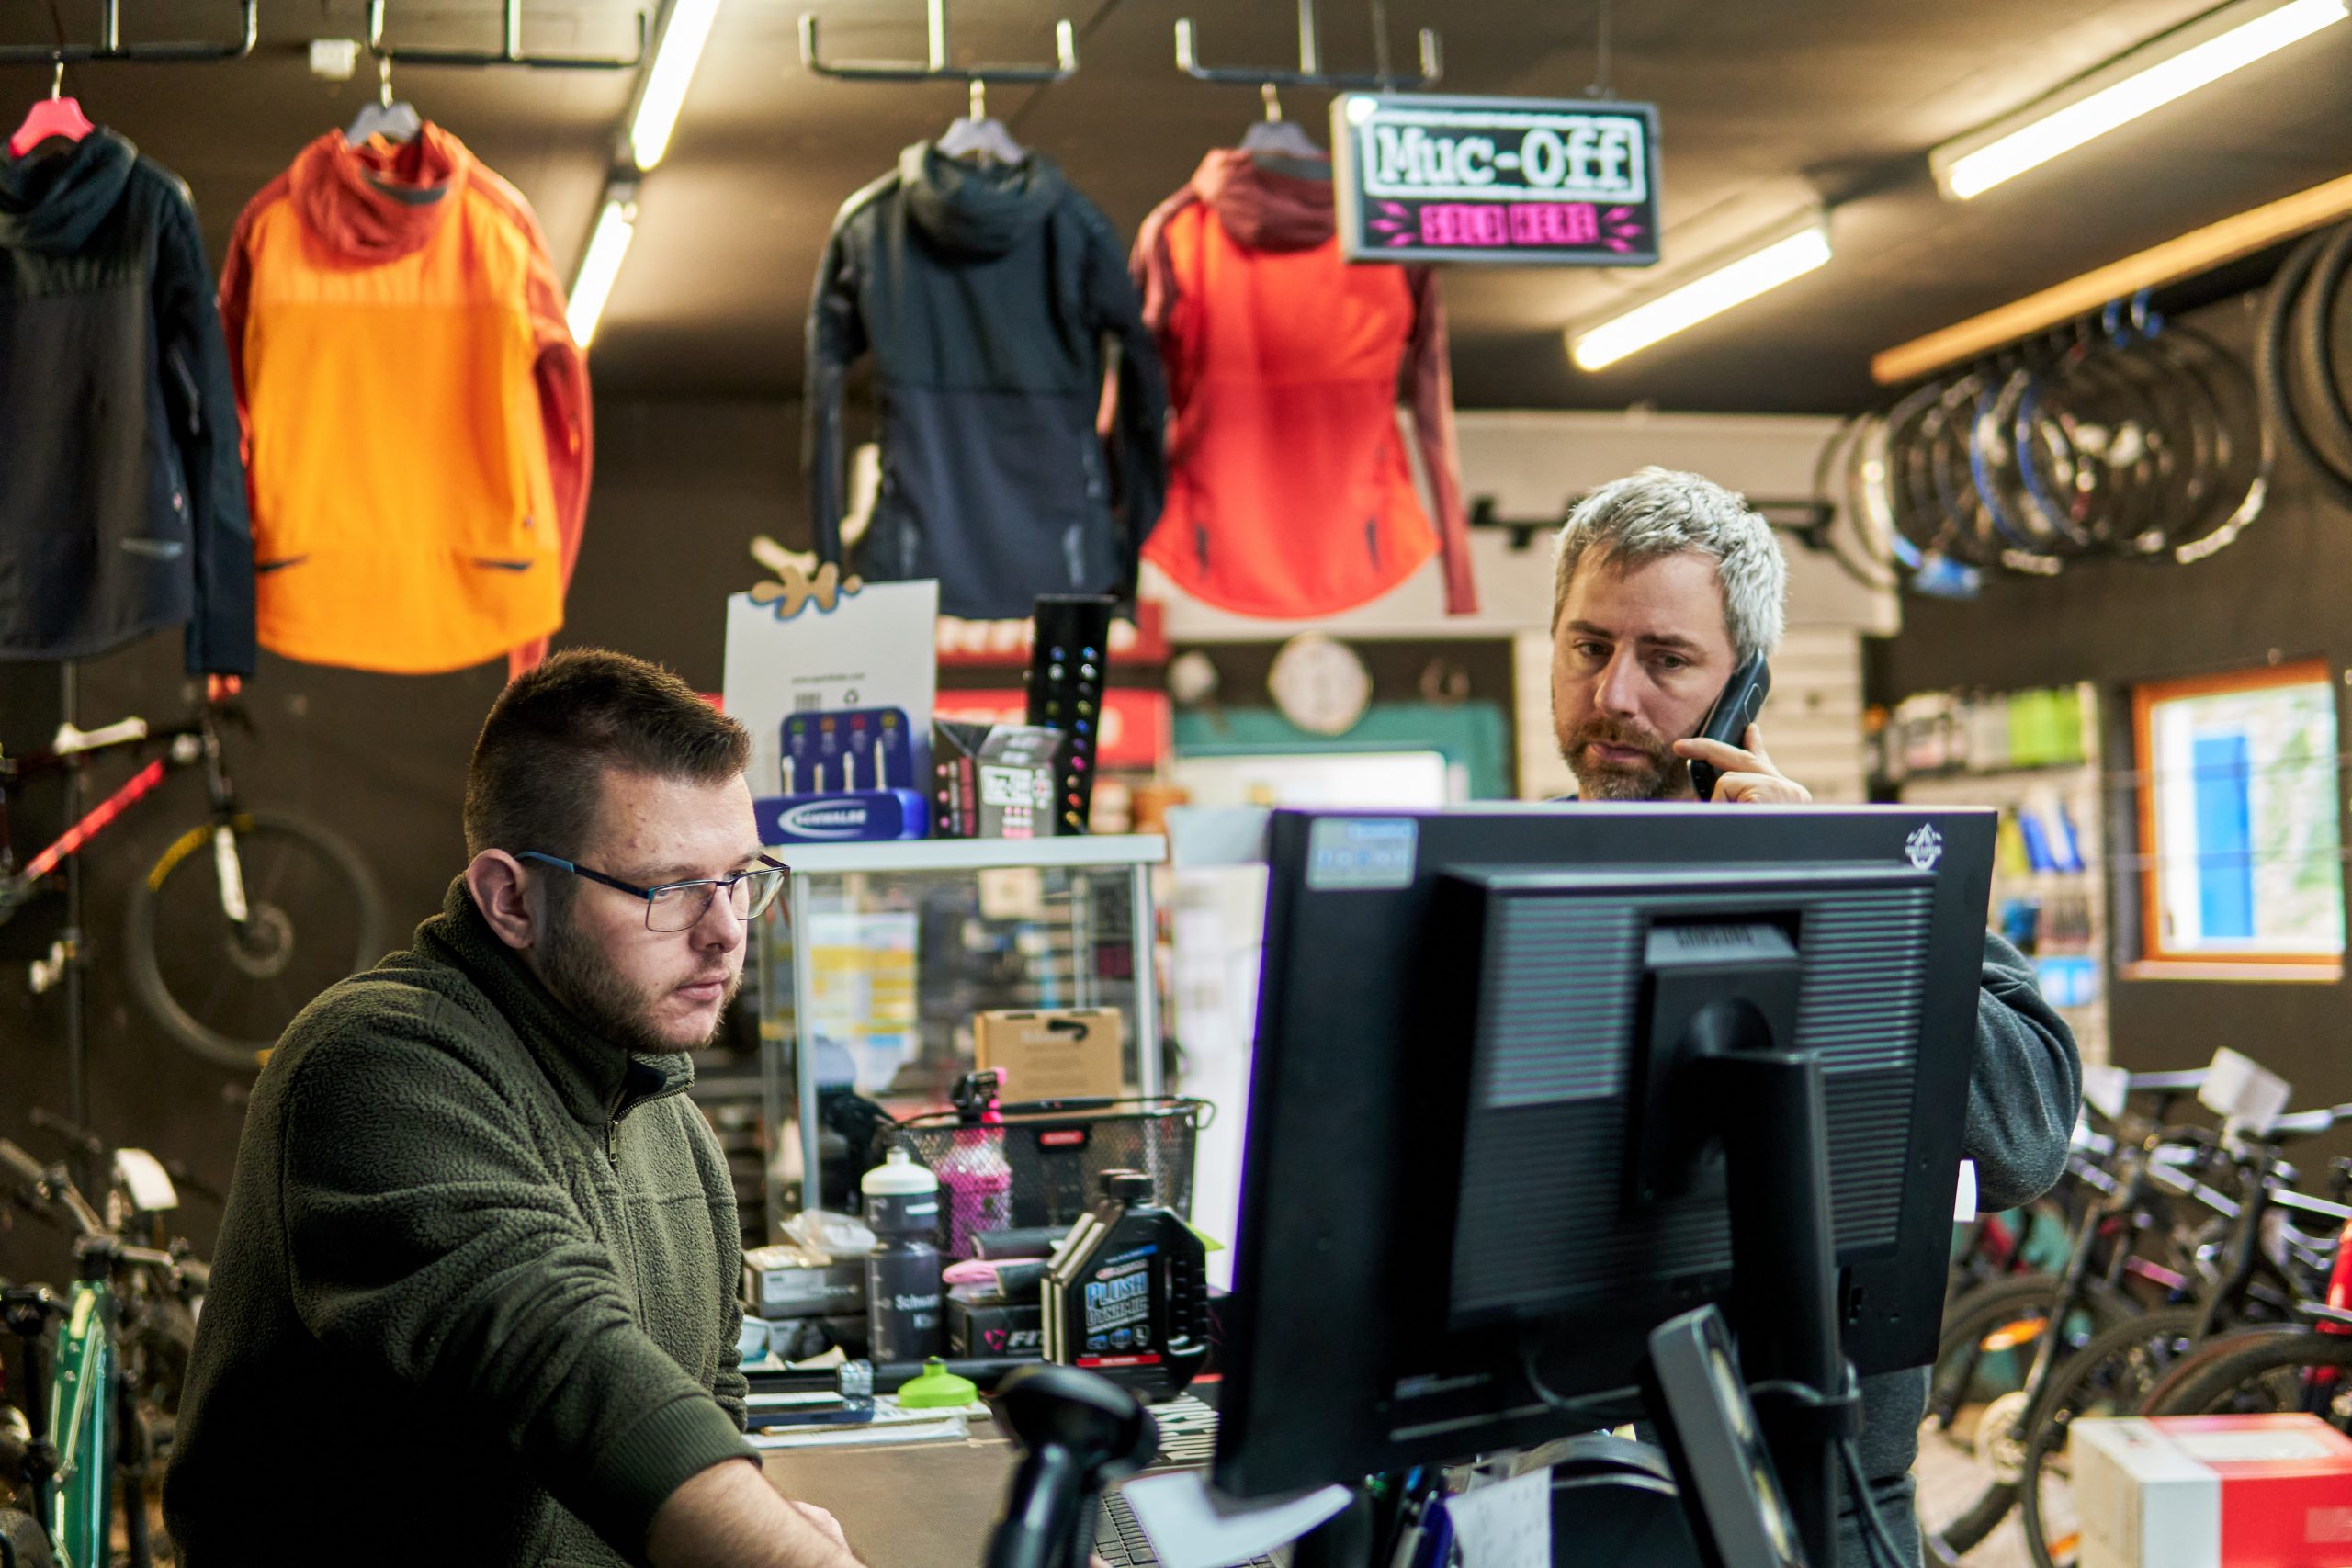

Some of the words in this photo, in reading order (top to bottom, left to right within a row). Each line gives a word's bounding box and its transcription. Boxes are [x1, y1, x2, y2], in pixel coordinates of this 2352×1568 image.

[1377, 125, 1630, 188] Muc-Off
[1085, 1271, 1148, 1309] PLUSH
[1007, 1331, 1046, 1348] FI
